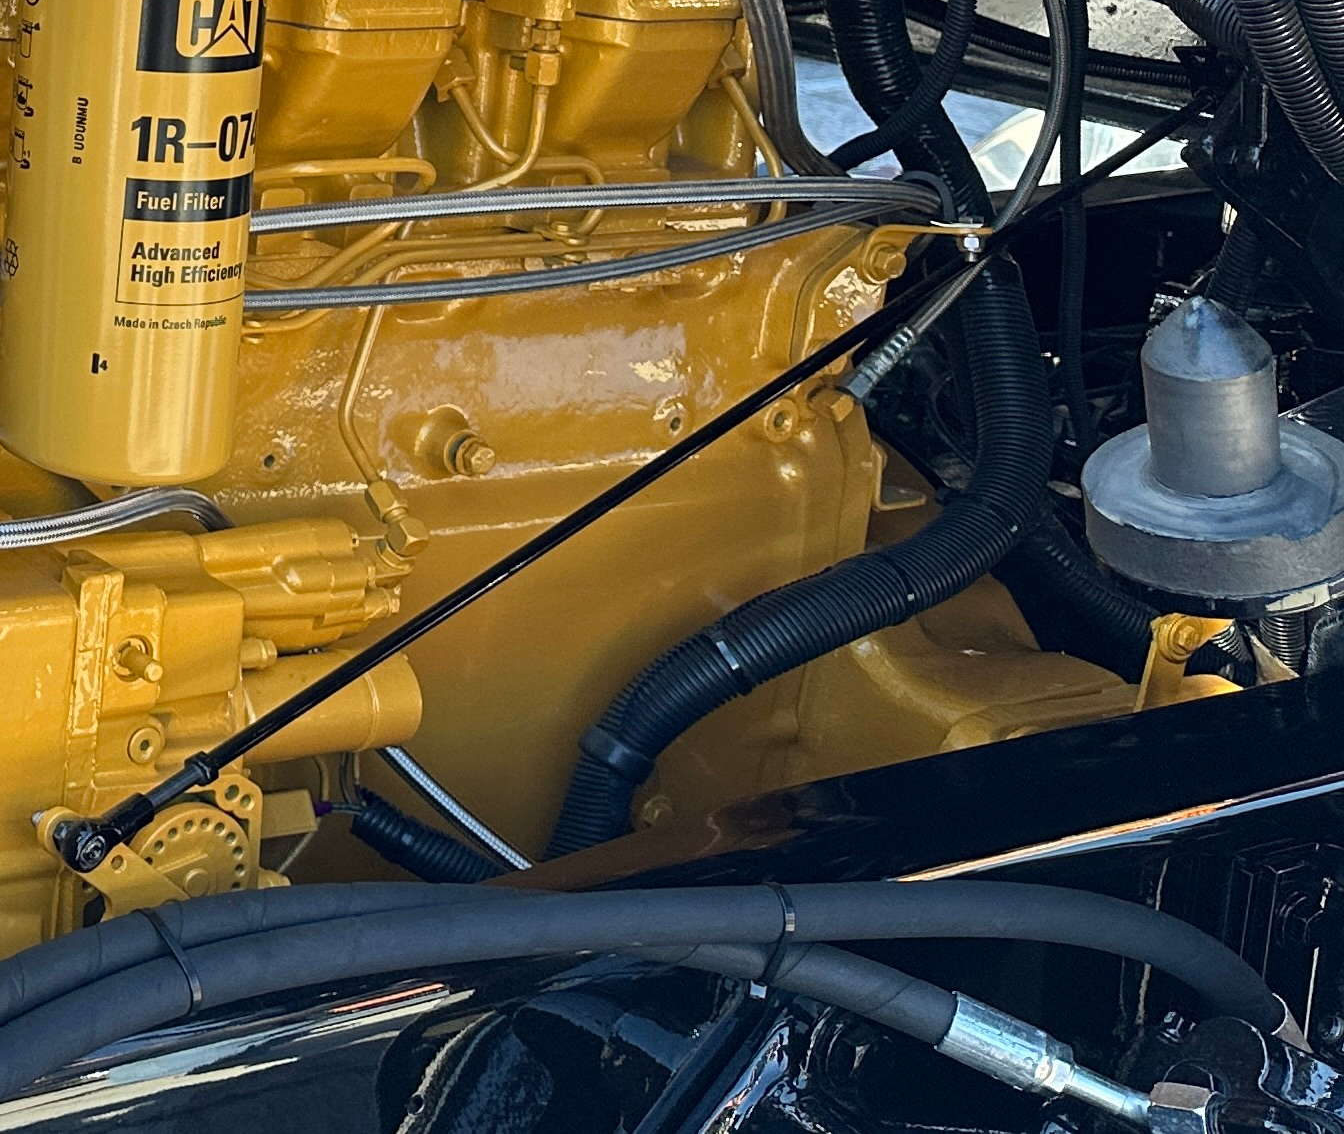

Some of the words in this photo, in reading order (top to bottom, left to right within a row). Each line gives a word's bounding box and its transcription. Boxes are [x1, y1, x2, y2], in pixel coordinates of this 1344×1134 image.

[71, 155, 83, 165] B
[136, 191, 178, 211] Fuel
[183, 192, 226, 211] Filter
[130, 240, 221, 261] Advanced
[130, 263, 176, 288] High
[180, 261, 243, 284] Efficiency
[113, 315, 146, 329] Made
[148, 317, 159, 330] in
[161, 318, 192, 330] Czech
